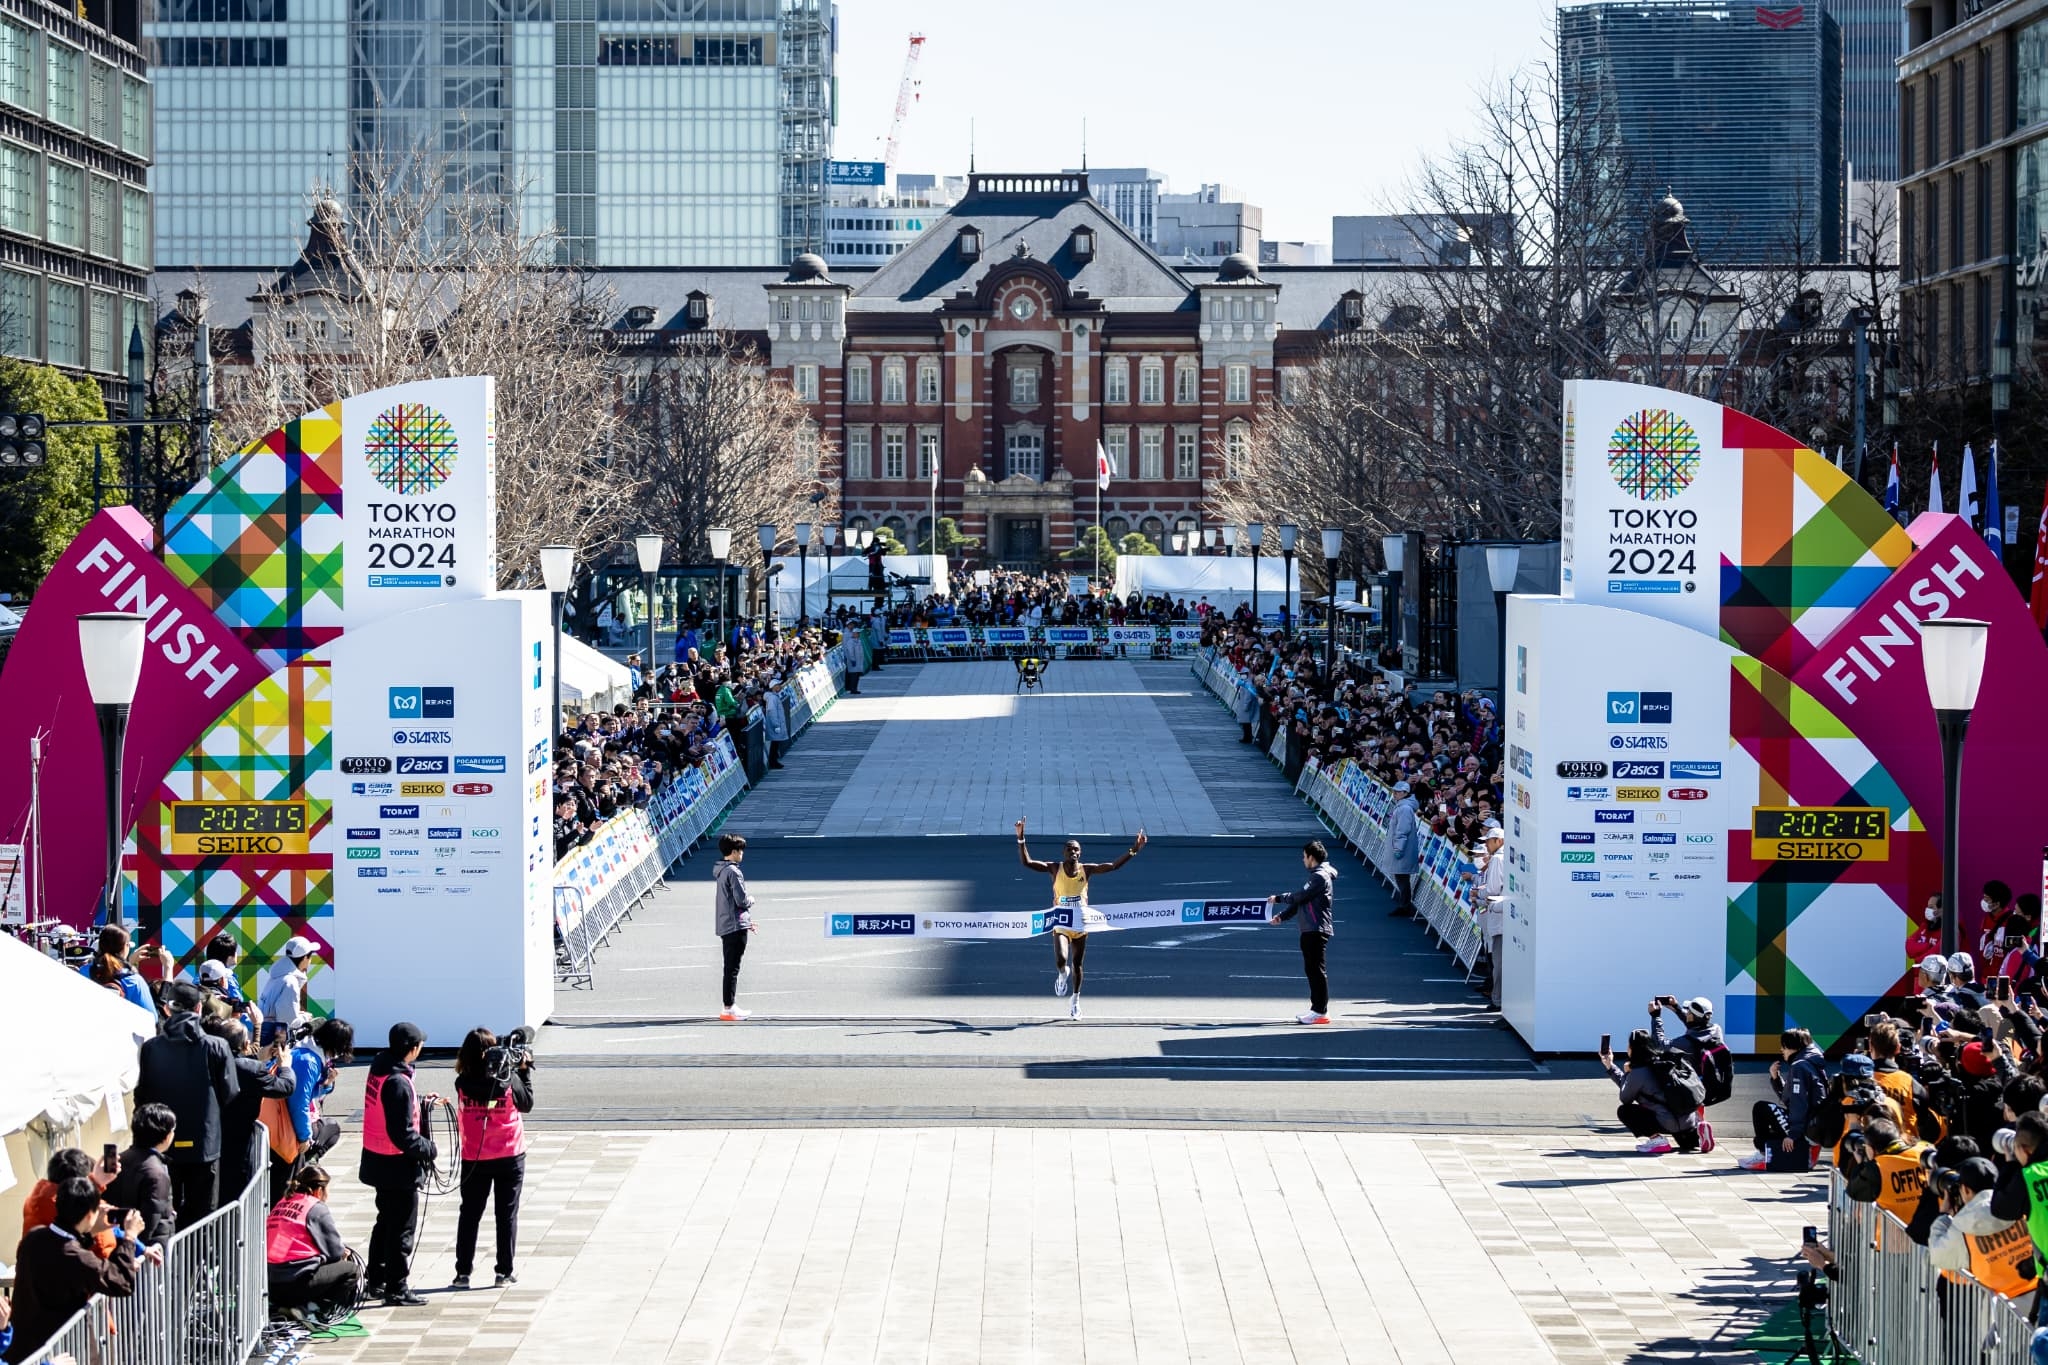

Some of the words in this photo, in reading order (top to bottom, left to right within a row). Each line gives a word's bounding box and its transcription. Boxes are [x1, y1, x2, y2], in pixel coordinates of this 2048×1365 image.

[368, 503, 456, 522] TOKYO
[1609, 509, 1697, 528] TOKYO
[369, 527, 454, 538] MARATHON
[1610, 533, 1696, 544] MARATHON
[368, 543, 456, 568] 2024
[1608, 548, 1696, 574] 2024
[76, 537, 239, 699] FINISH
[1822, 544, 1985, 705] FINISH
[409, 731, 451, 743] STARTS
[1625, 736, 1667, 749] STARTS
[347, 758, 386, 767] TOKIO
[414, 760, 443, 771] asics
[1562, 762, 1602, 771] TOKIO
[1630, 765, 1659, 775] asics
[402, 785, 444, 794] SEIKO
[1618, 790, 1659, 799] SEIKO
[1672, 790, 1704, 798] 第一生命
[200, 808, 300, 830] 2:02:15
[1780, 813, 1880, 837] 2:02:15
[428, 830, 459, 838] Salonpas
[1643, 835, 1673, 843] Salonpas
[198, 836, 283, 853] SEIKO
[349, 849, 379, 857] バスクリン
[1777, 842, 1862, 859] SEIKO
[1562, 853, 1593, 862] バスクリン
[1091, 913, 1112, 921] TOKYO
[1112, 911, 1154, 920] MARATHON
[1155, 909, 1175, 917] 2024
[1208, 905, 1261, 916] 東京メトロ
[857, 919, 911, 930] 東京メトロ
[934, 921, 962, 929] TOKYO
[964, 921, 1010, 929] MARATHON
[1012, 921, 1028, 929] 2024
